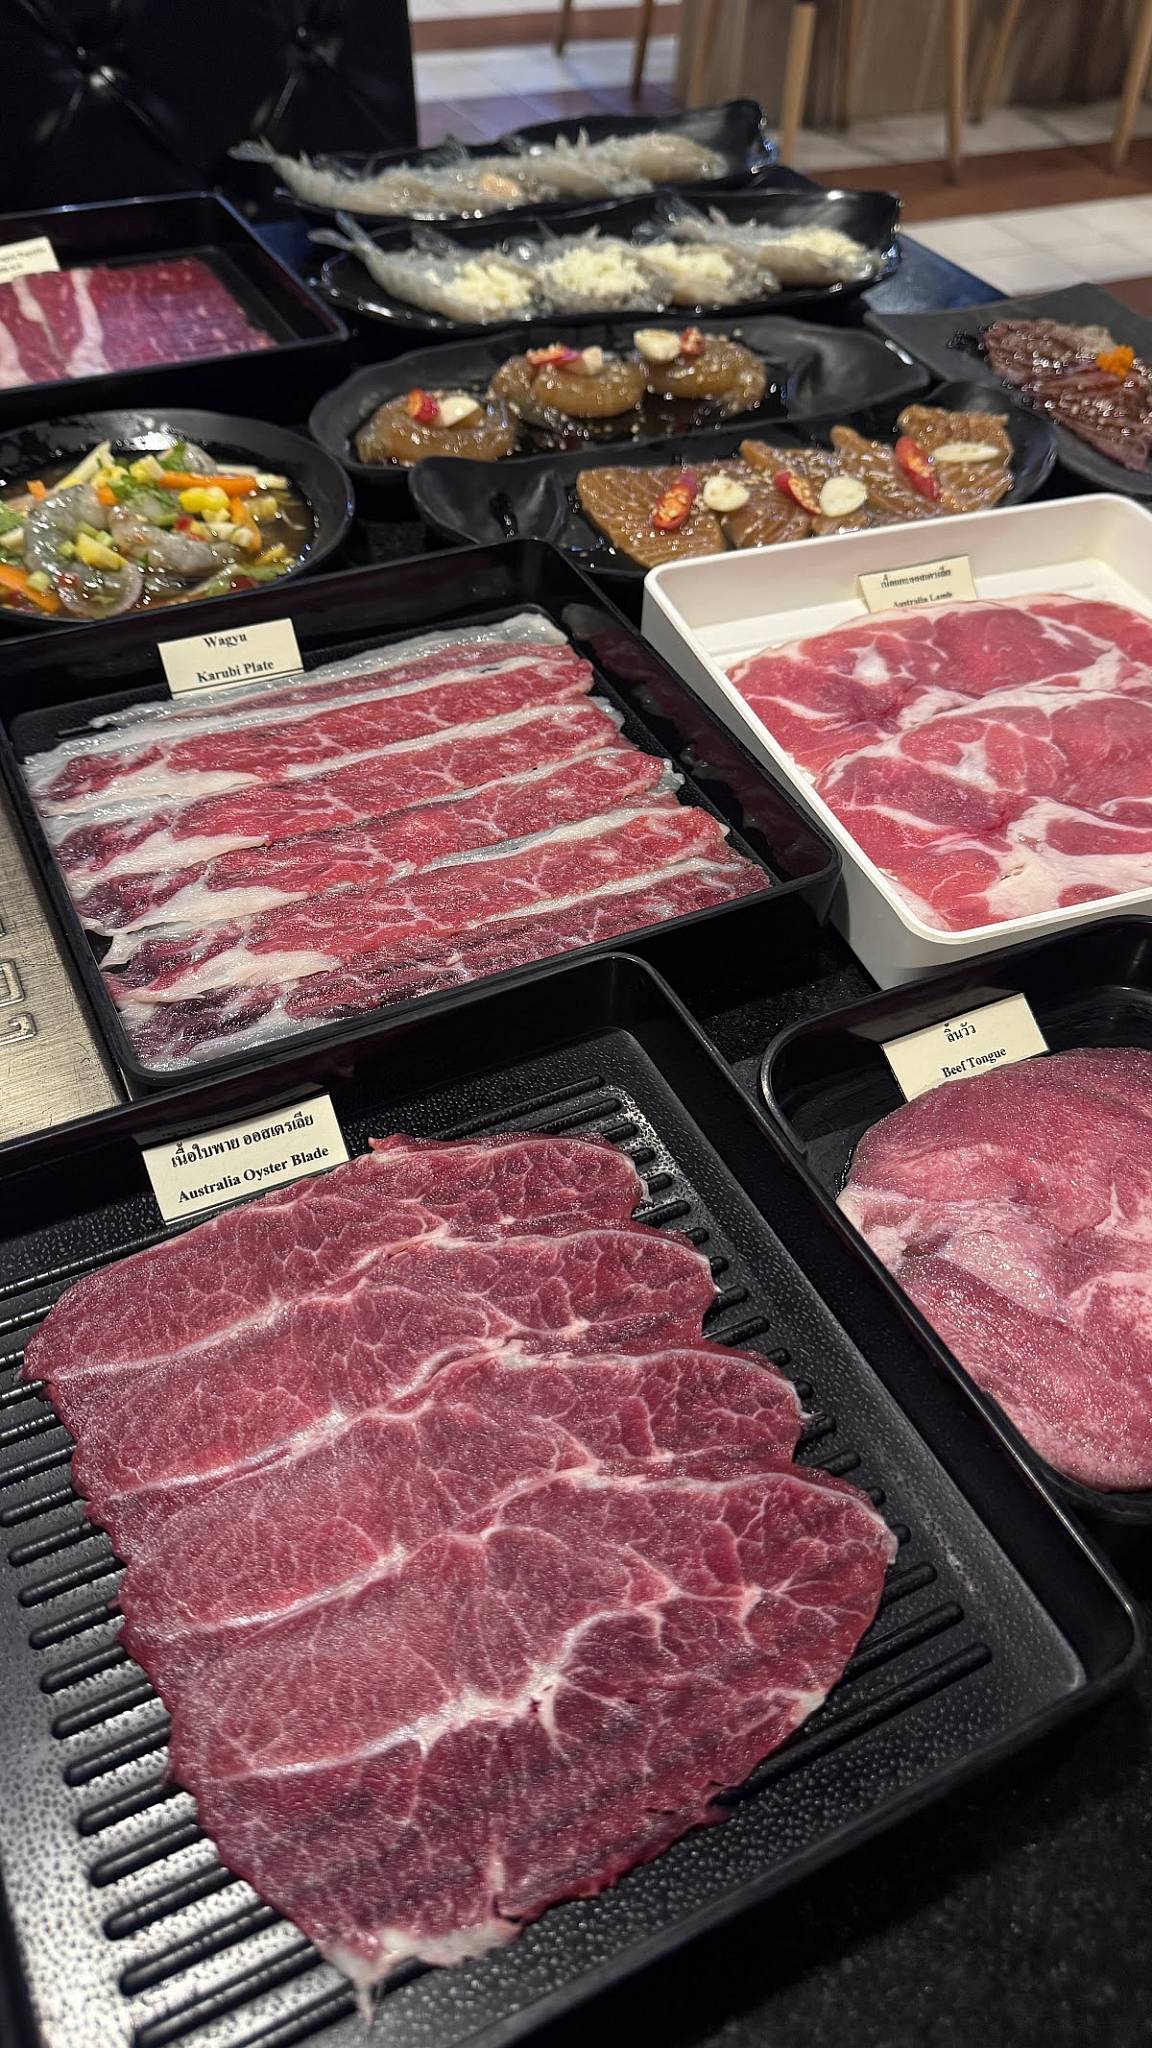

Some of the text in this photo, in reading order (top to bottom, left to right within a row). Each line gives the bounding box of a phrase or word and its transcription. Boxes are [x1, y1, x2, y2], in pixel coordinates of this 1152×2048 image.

[929, 591, 953, 602] Lamb
[203, 633, 248, 648] Wagyu
[196, 660, 275, 683] Karubi Plate
[943, 1021, 977, 1043] ลิ้นวัว
[941, 1048, 1007, 1078] Beef Tongue
[171, 1111, 315, 1168] เนื้อใบพาย ออสเตรเลีย
[178, 1145, 330, 1203] Australia Oyster Blade
